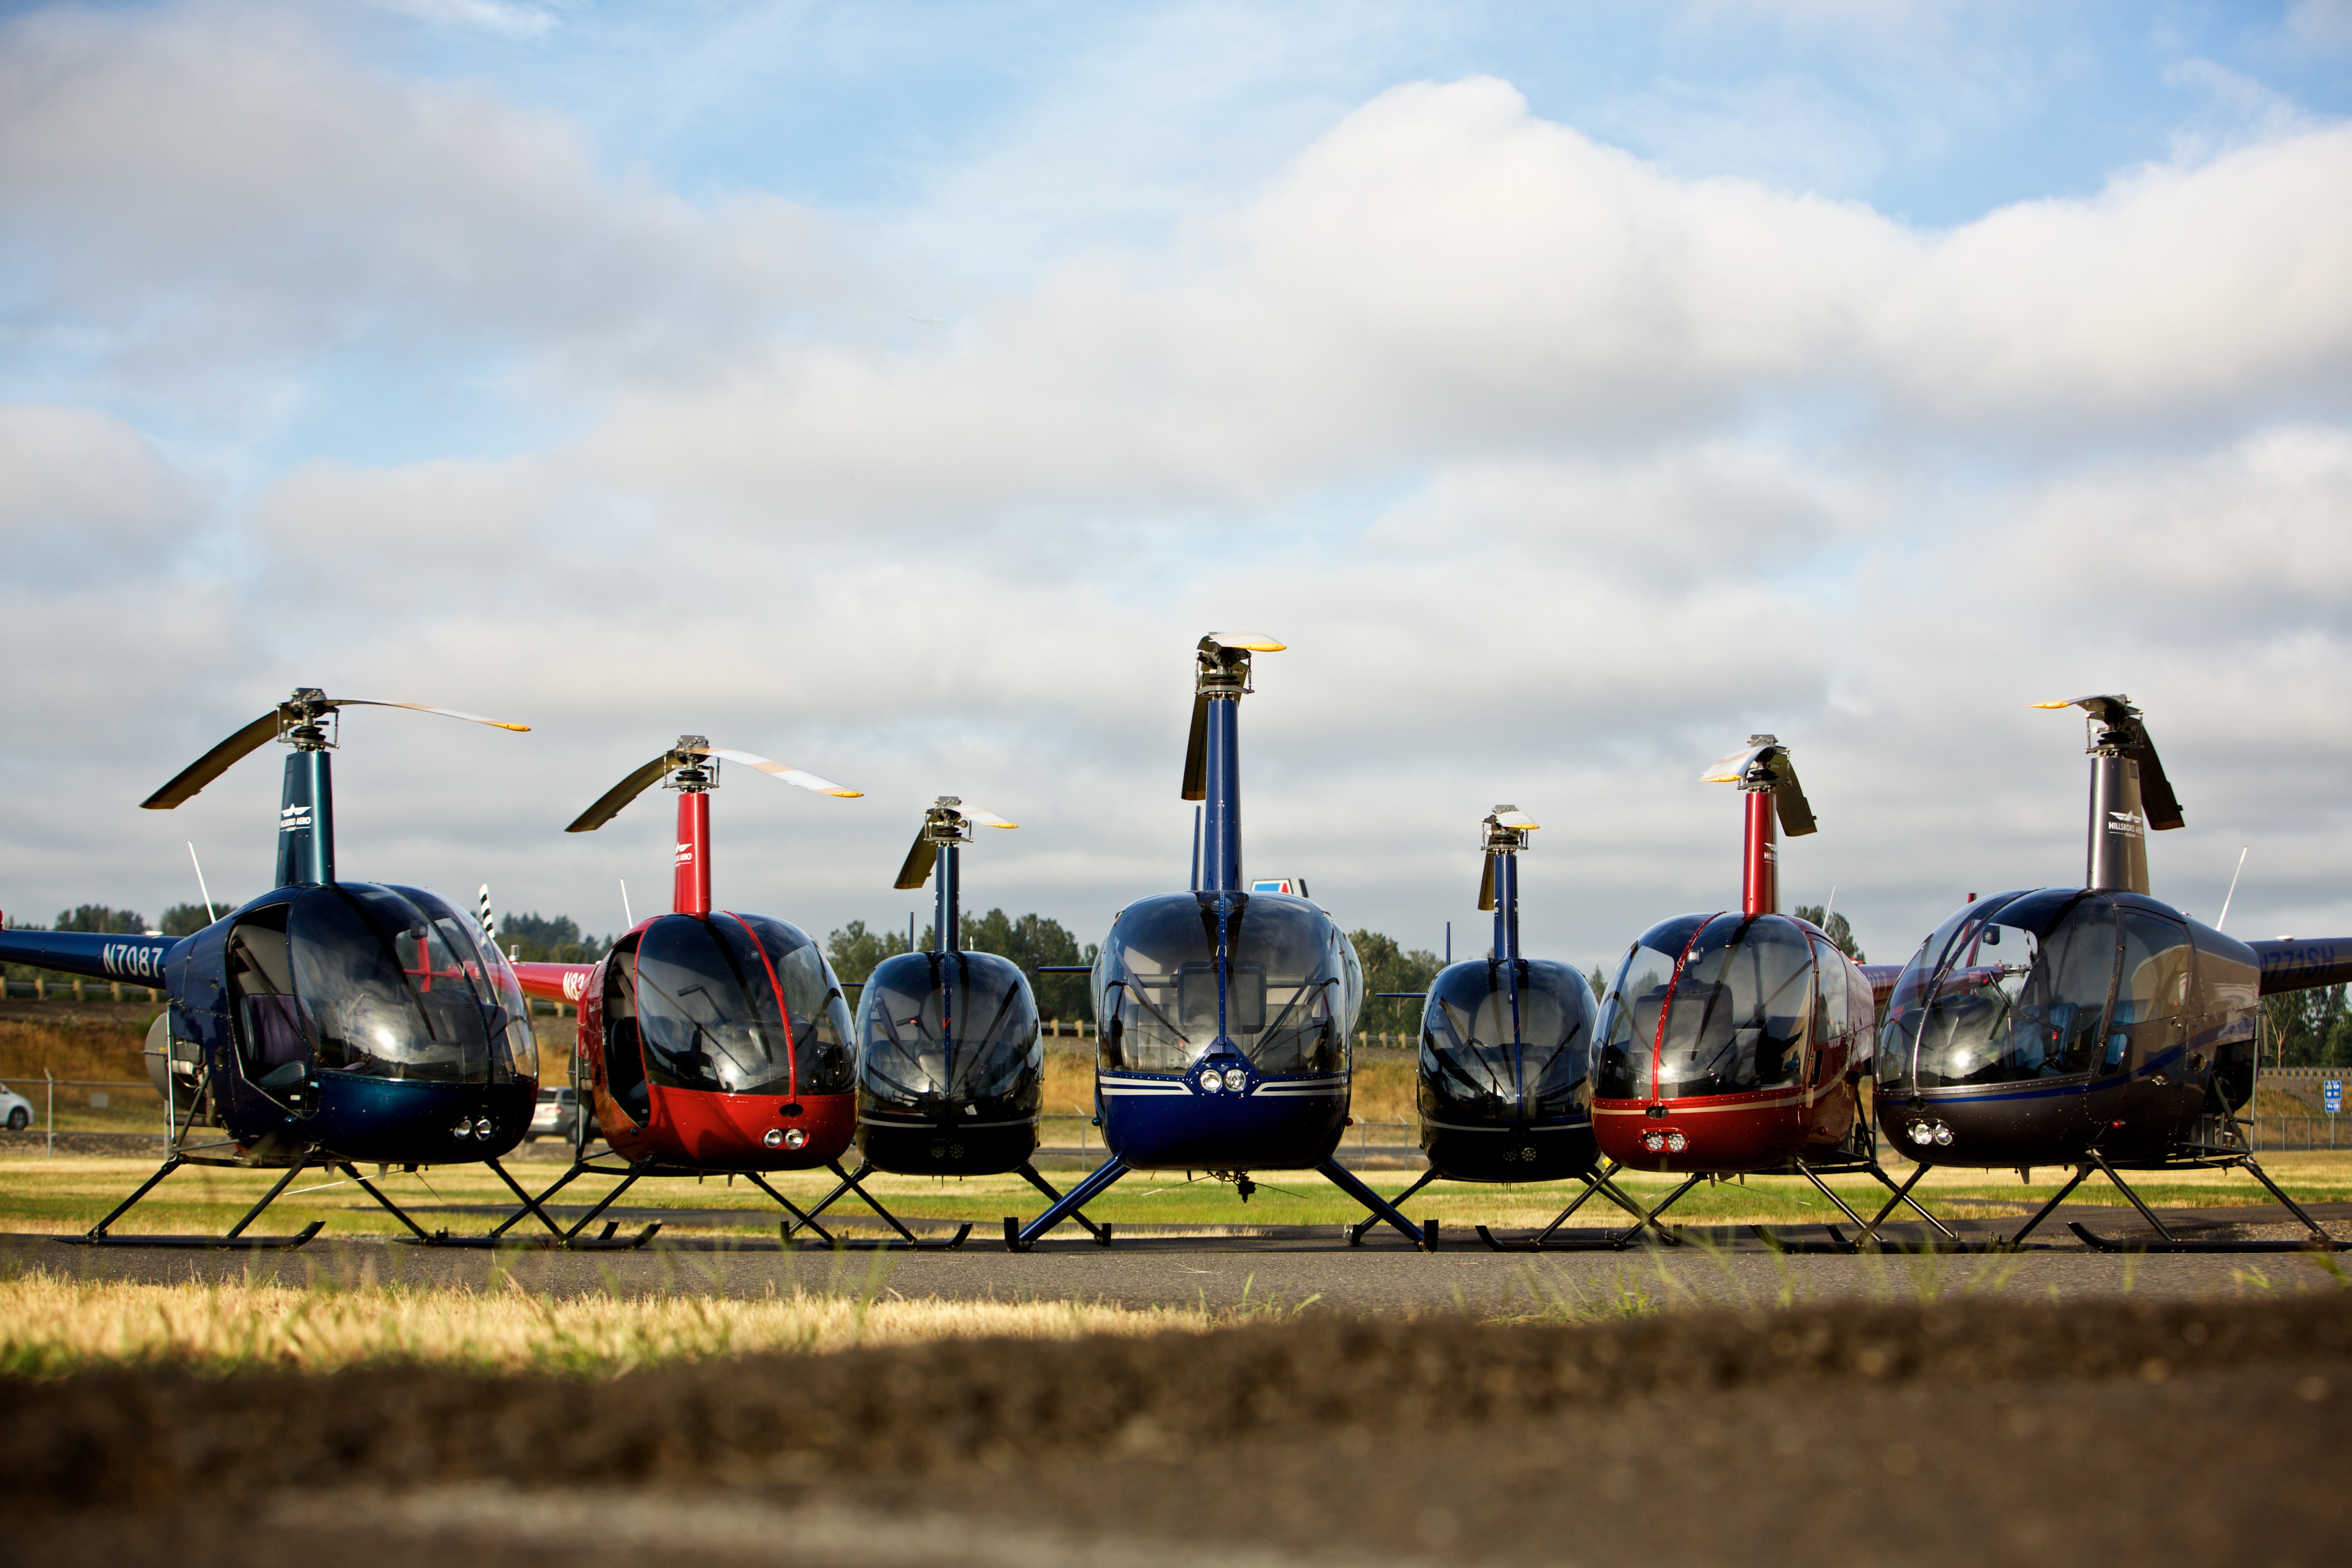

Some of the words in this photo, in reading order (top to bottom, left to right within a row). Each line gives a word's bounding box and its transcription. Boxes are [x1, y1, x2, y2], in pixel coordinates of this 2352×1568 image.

[296, 816, 312, 825] AERO
[2108, 822, 2135, 832] HILLSBORO
[103, 943, 166, 978] N7087
